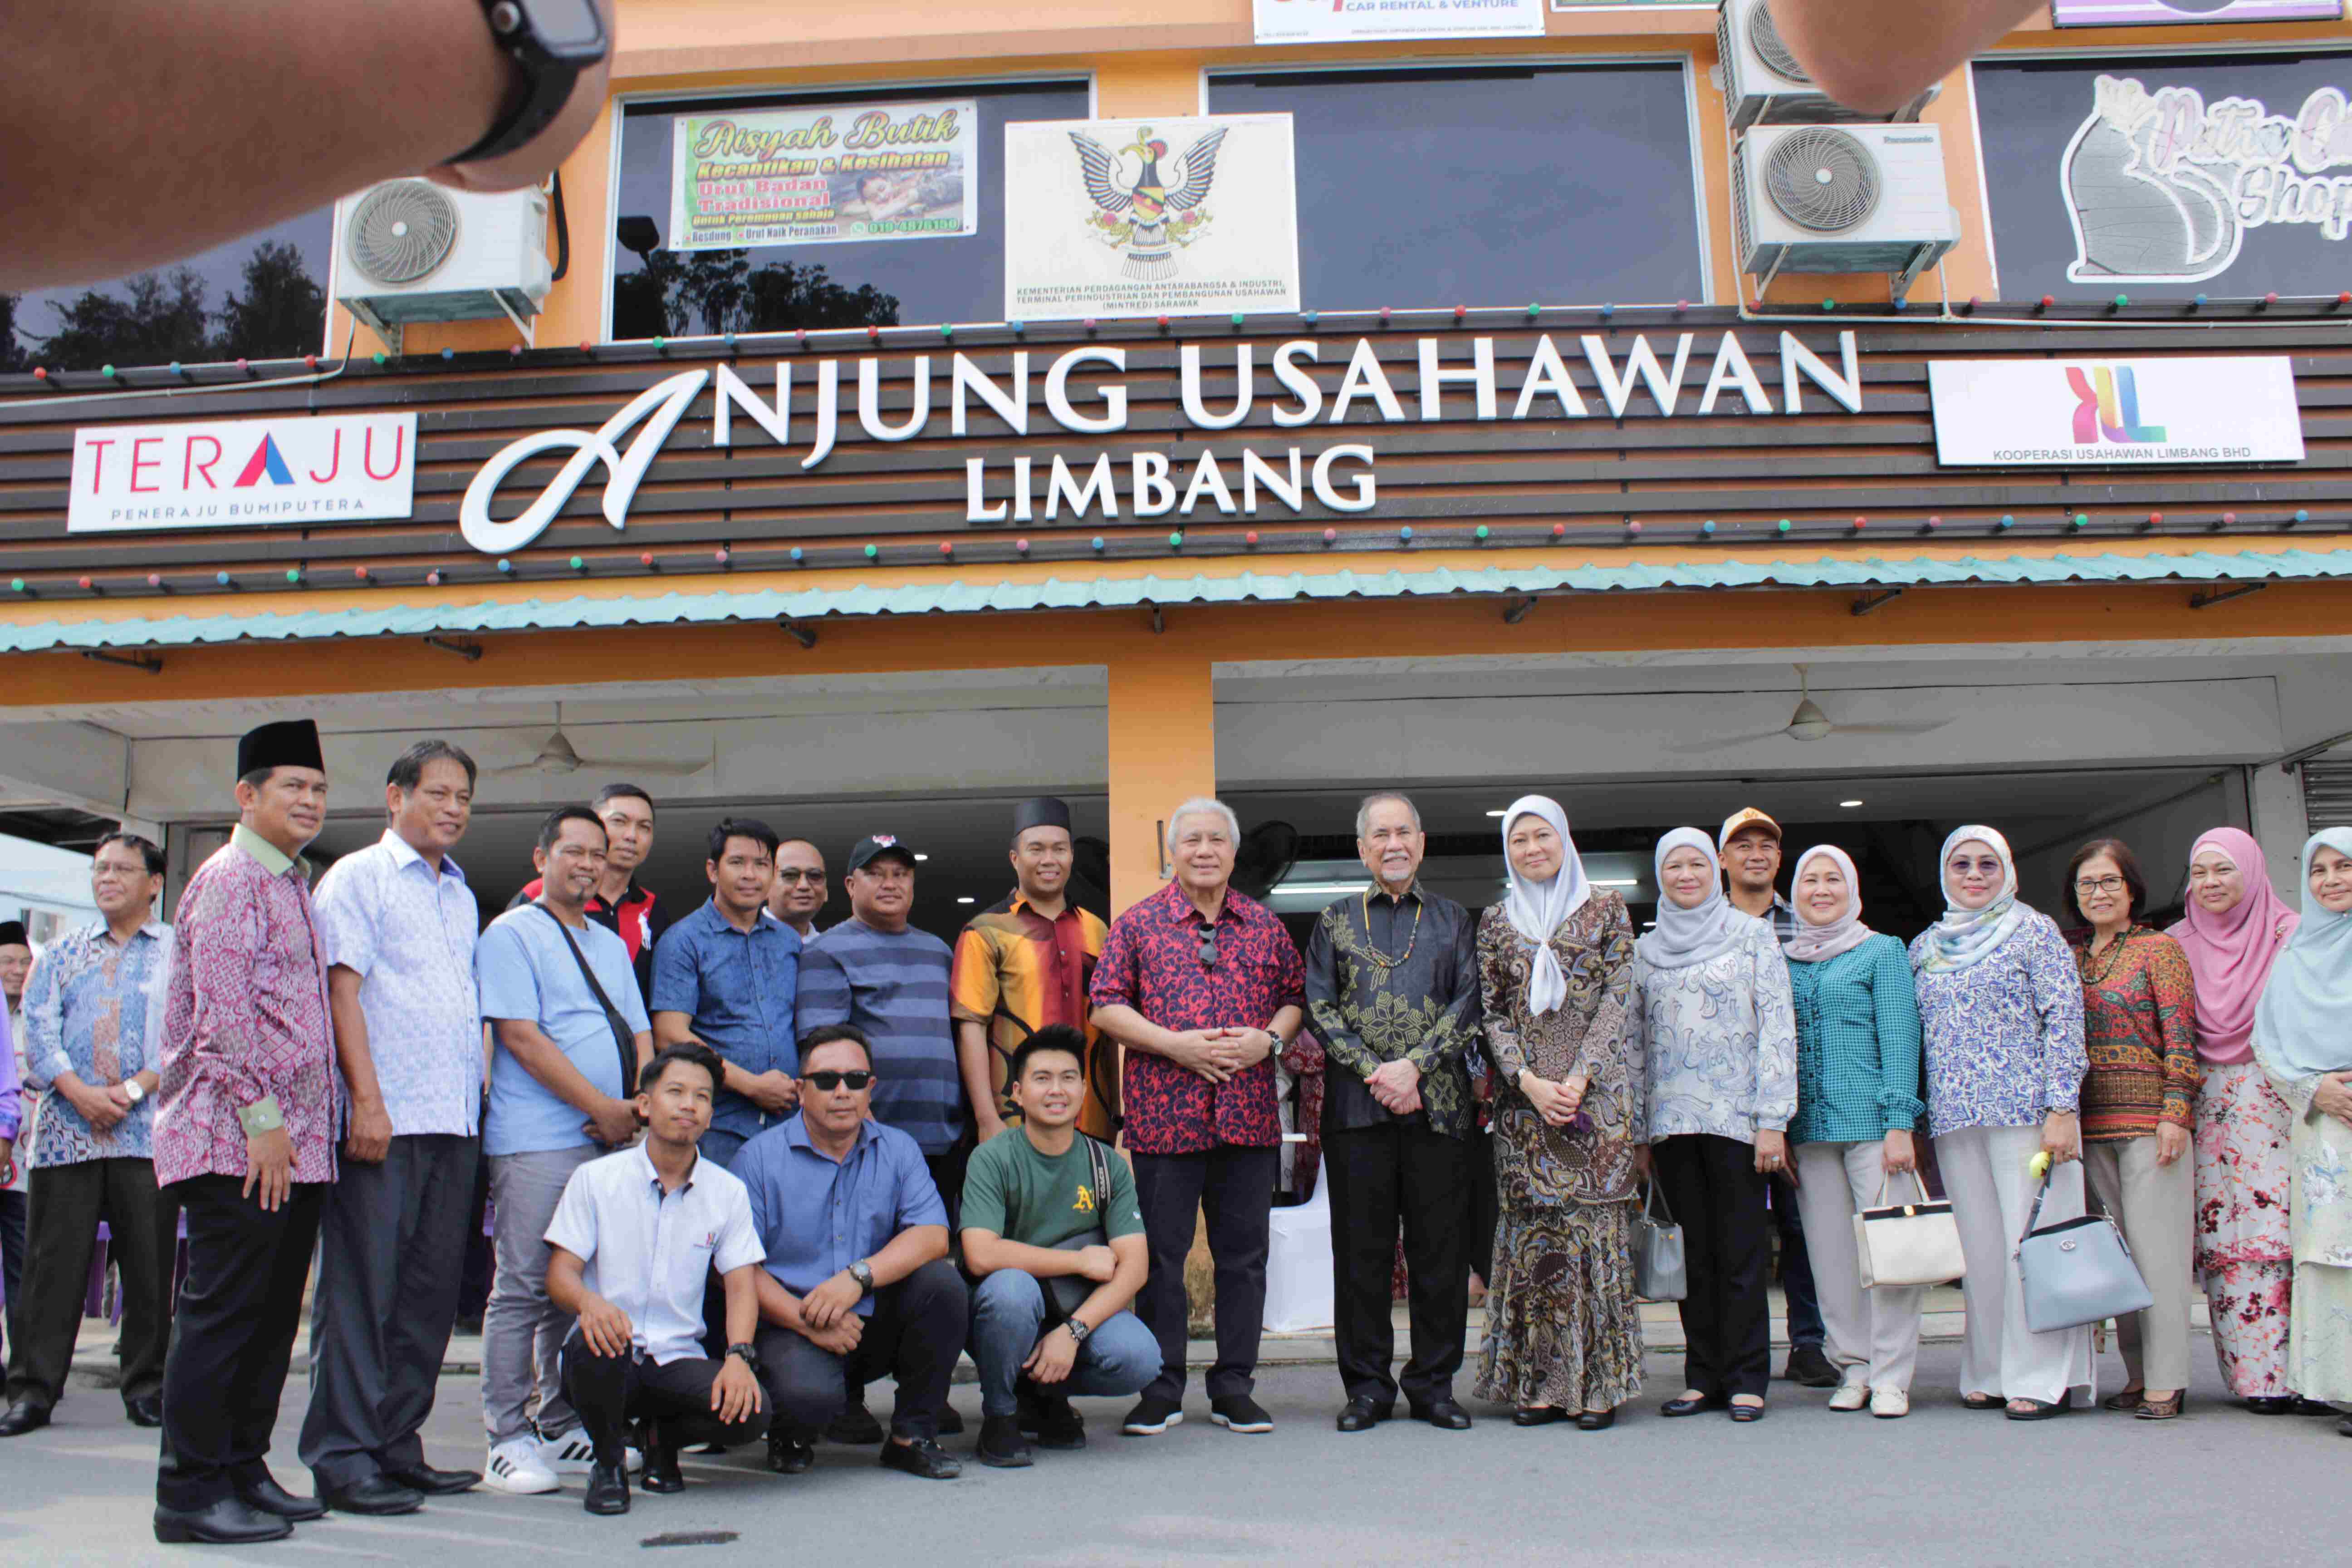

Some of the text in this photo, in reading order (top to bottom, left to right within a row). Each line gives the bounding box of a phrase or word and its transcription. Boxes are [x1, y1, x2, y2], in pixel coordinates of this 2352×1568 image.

[1346, 2, 1375, 11] CAR
[1380, 0, 1436, 10] RENTAL
[694, 109, 960, 162] Aisyah Butik
[696, 152, 949, 181] Kecantikan & Kesihatan
[698, 177, 827, 195] Urut Badan
[697, 191, 830, 211] Tradisional
[746, 228, 765, 239] Urut
[767, 227, 786, 237] Naik
[789, 225, 838, 236] Peranakan
[1017, 287, 1081, 295] KEMENTERIAN
[1085, 283, 1152, 292] PERDAGANGAN
[1155, 281, 1227, 290] ANTARABANGSA
[1017, 295, 1062, 304] TERMINAL
[1065, 293, 1138, 302] PERINDUSTRIAN
[1162, 289, 1232, 298] PEMBANGUNAN
[1235, 288, 1286, 296] USAHAWAN
[1103, 300, 1199, 310] (MINTRED) SARAWAK
[459, 331, 1862, 554] ANJUNG USAHAWAN
[86, 425, 403, 494] TERAJU
[1994, 447, 2250, 460] KOOPERASI USAHAWAN LIMBANG BHD
[966, 444, 1376, 522] LIMBANG
[112, 499, 364, 520] PENERAJU BUMIPUTERA
